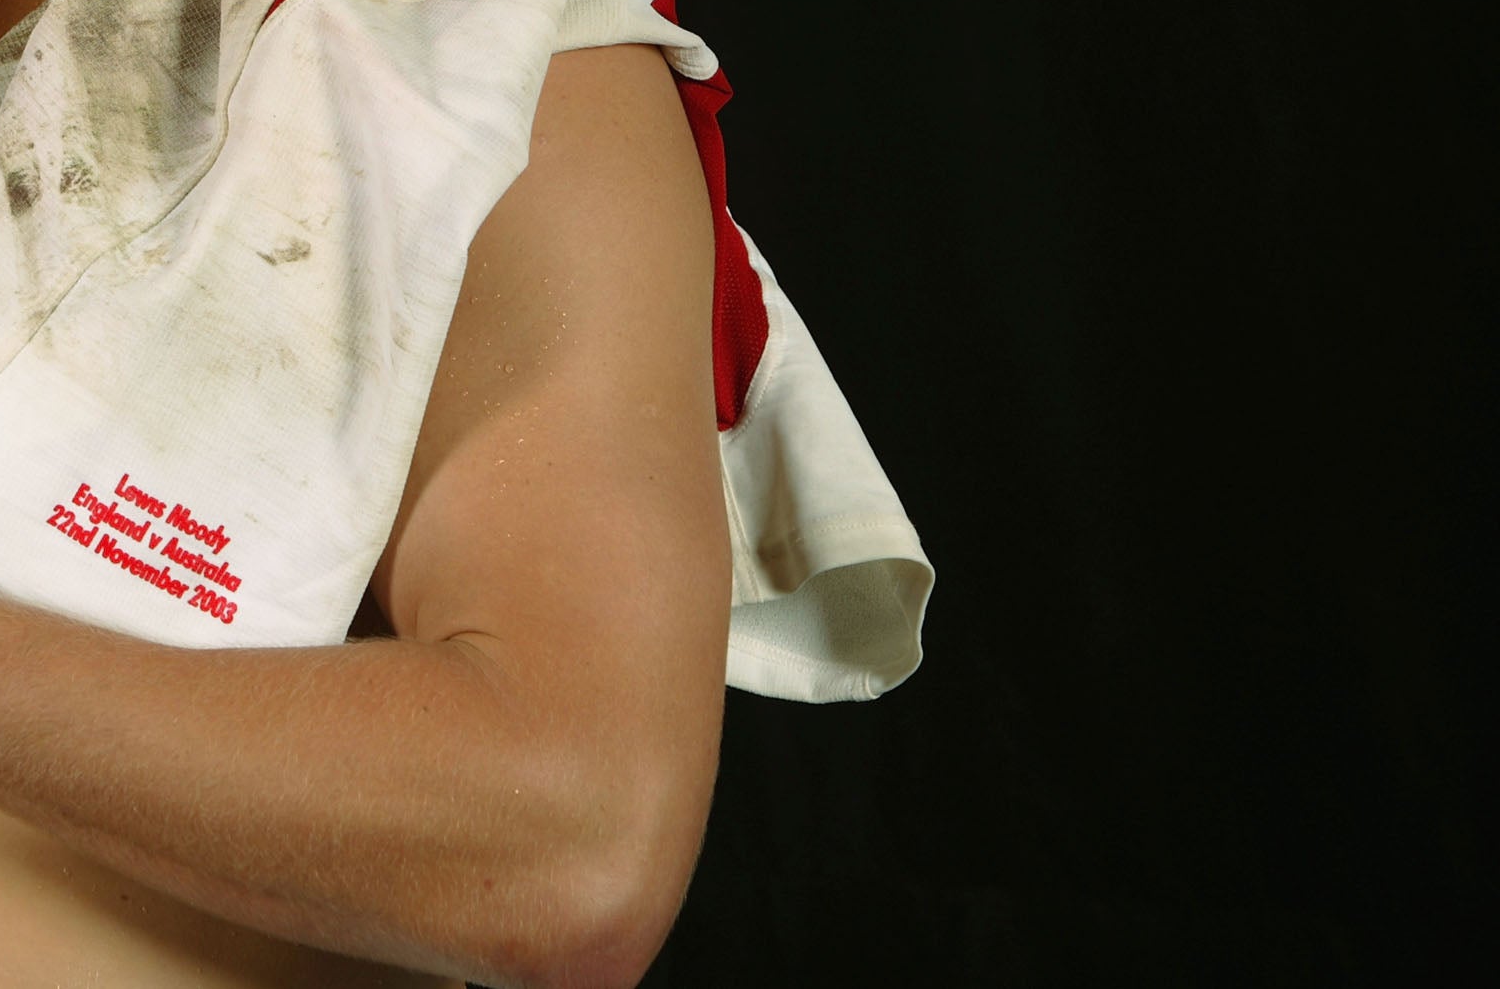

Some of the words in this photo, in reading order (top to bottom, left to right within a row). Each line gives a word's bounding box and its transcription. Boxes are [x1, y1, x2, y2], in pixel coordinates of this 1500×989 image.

[46, 504, 99, 548] 22nd
[94, 533, 190, 599] November
[187, 584, 238, 625] 2003
[71, 482, 151, 543] England
[148, 532, 163, 550] v
[160, 536, 242, 592] Australia
[113, 473, 168, 518] Lewis
[165, 503, 231, 555] Moody
